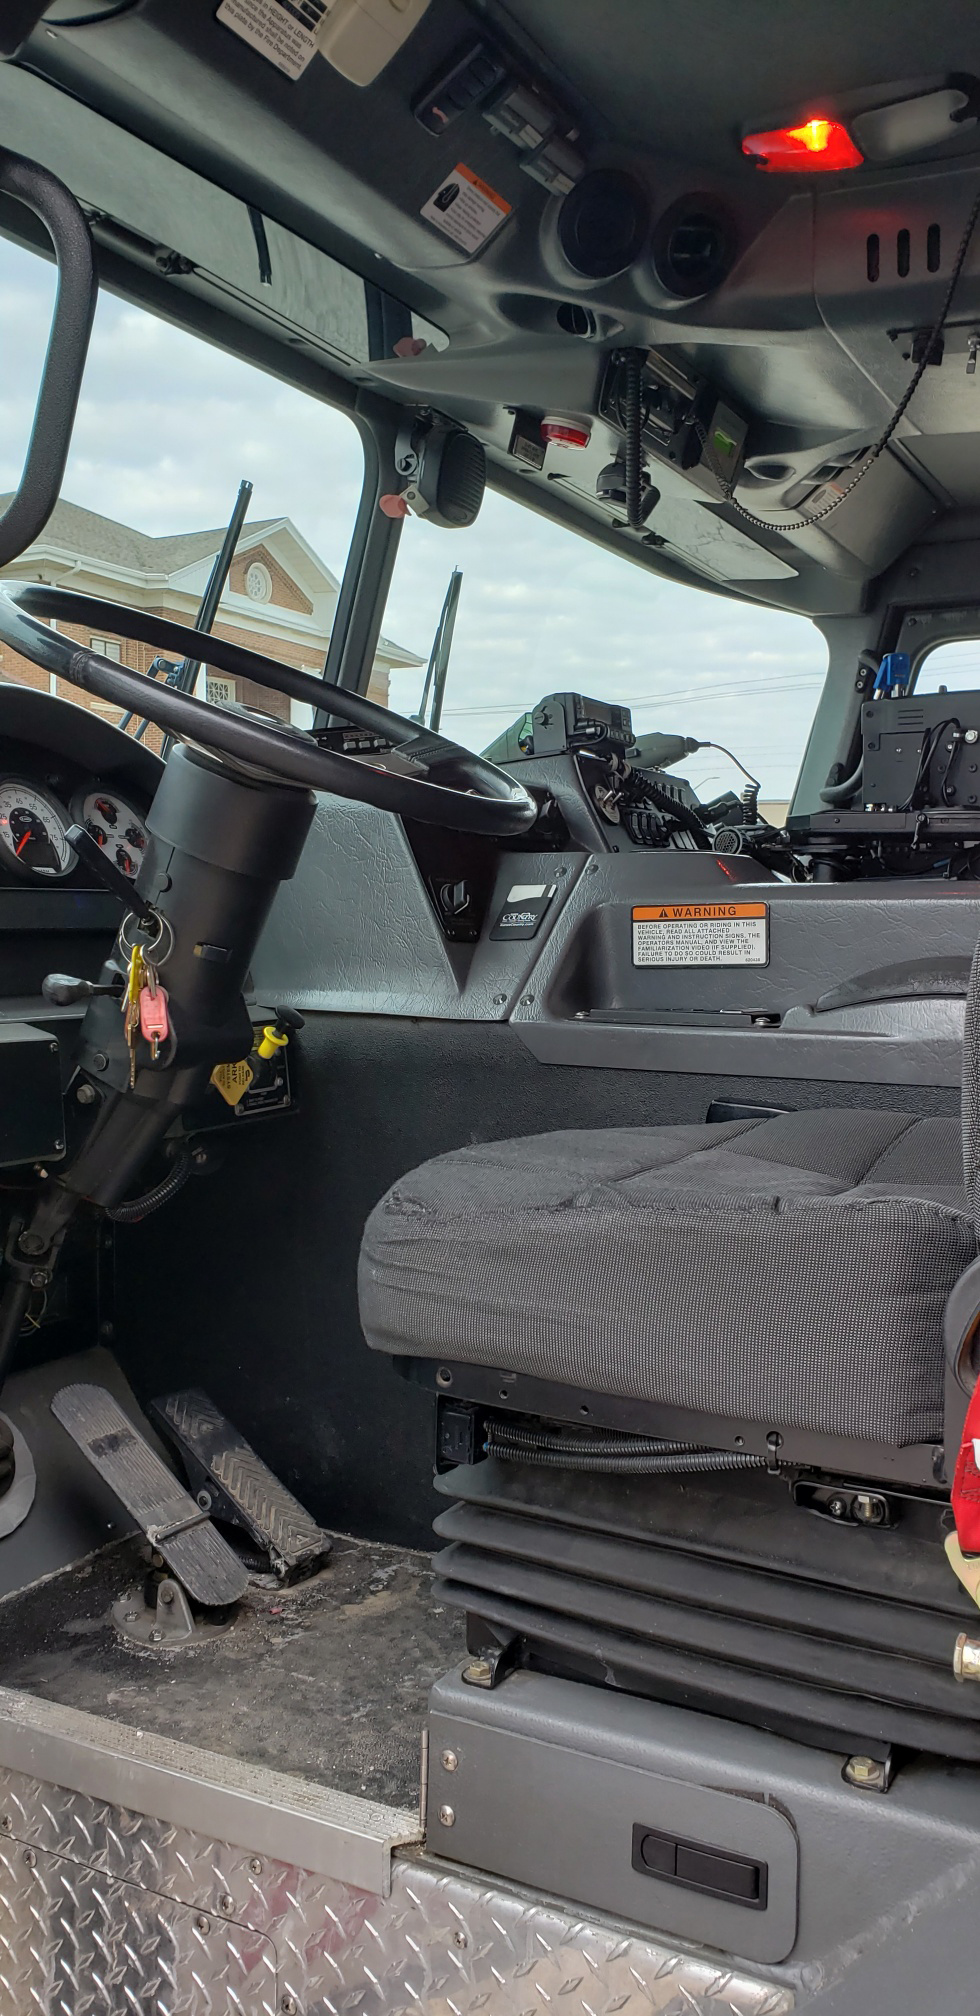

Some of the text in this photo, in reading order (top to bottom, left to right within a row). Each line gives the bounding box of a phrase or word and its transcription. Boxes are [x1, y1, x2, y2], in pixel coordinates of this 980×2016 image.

[224, 2, 236, 14] this
[233, 12, 249, 26] plate
[247, 22, 255, 32] by
[254, 28, 264, 38] the
[262, 35, 274, 47] Fire
[258, 9, 268, 20] the
[265, 16, 293, 41] Apparatus
[290, 38, 302, 49] was
[268, 6, 289, 26] HEIGHT
[293, 28, 315, 48] LENGTH
[264, 26, 278, 40] shall
[276, 35, 285, 45] be
[283, 41, 299, 57] noted
[297, 54, 305, 62] on
[28, 803, 38, 811] 55
[50, 833, 59, 841] 75
[672, 906, 737, 918] WARNING
